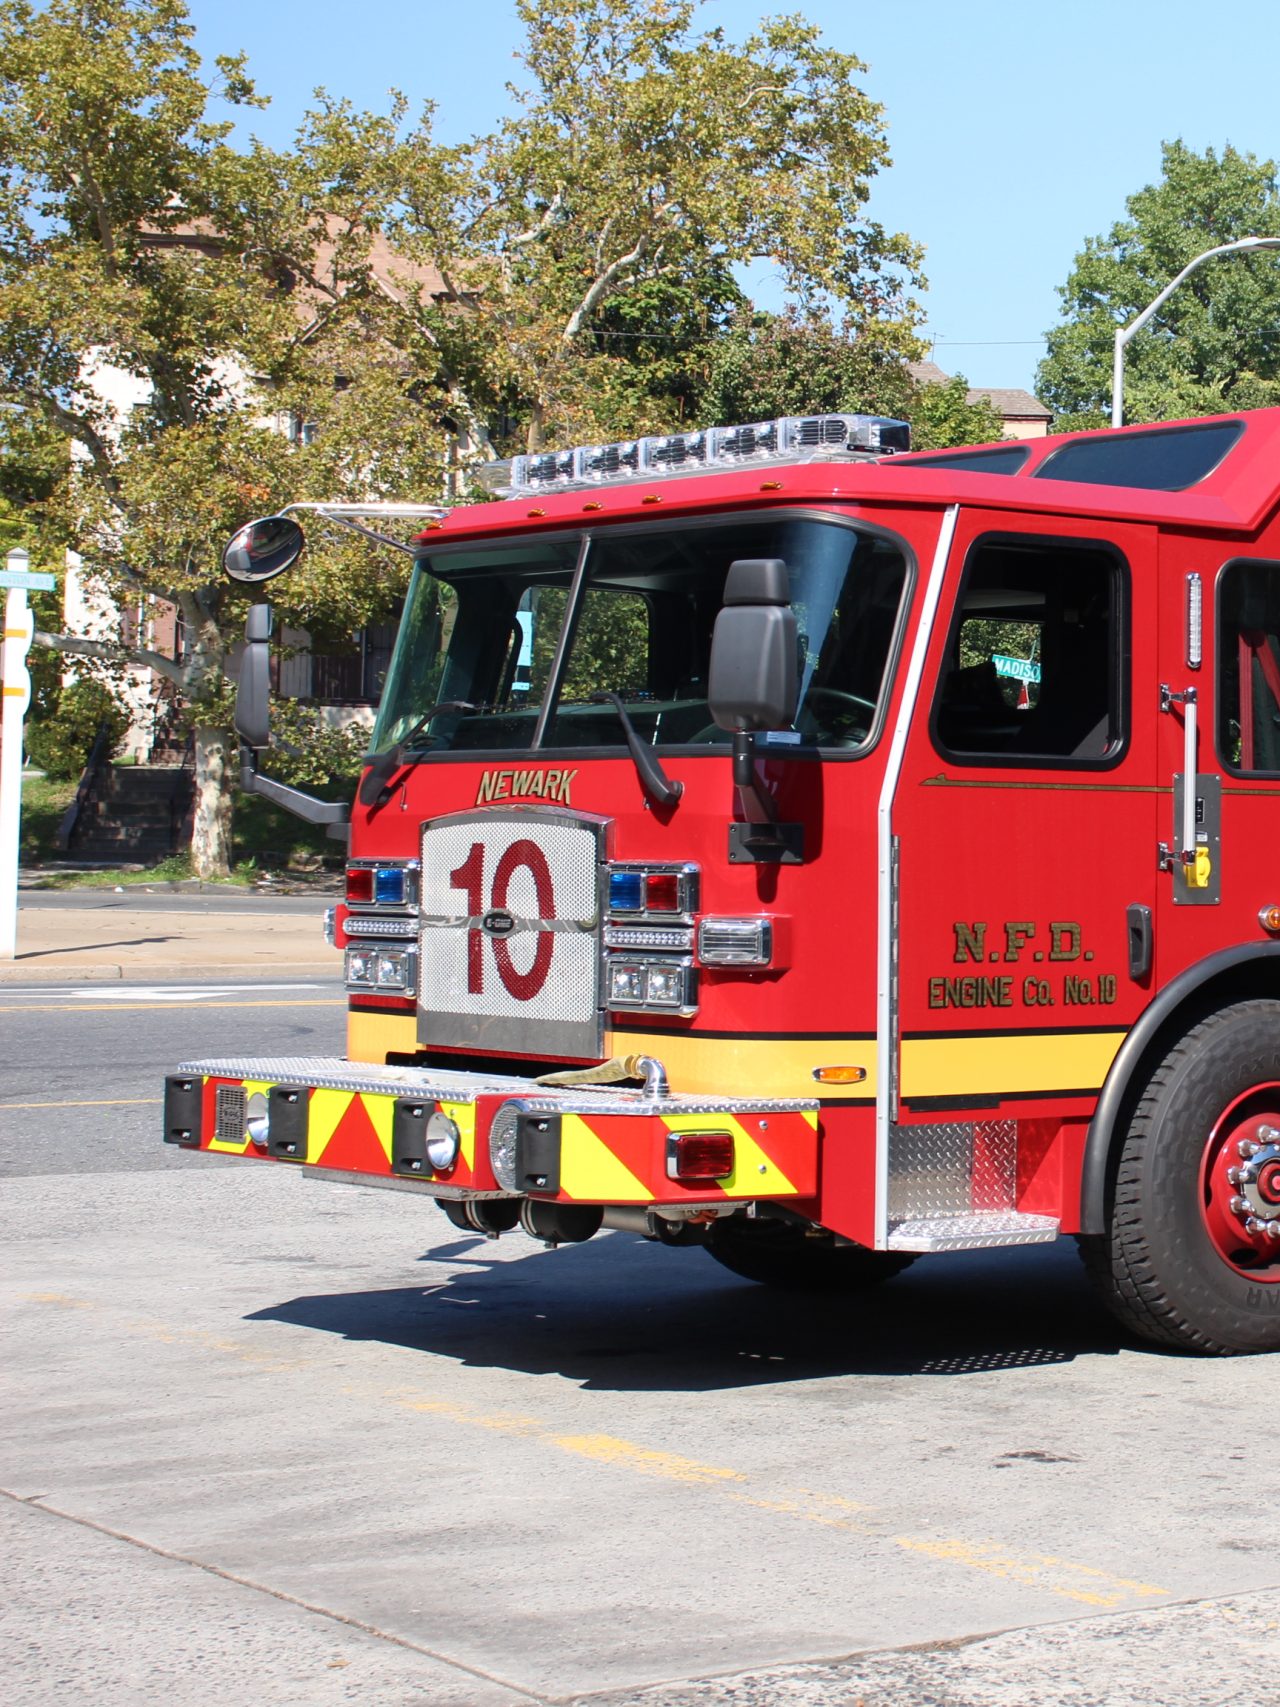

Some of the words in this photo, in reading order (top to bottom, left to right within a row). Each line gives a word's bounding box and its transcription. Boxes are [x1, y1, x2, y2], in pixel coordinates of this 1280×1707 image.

[475, 769, 578, 806] NEWARK
[450, 839, 556, 1001] 10
[954, 922, 1094, 963] N.F.D.
[928, 976, 1014, 1009] ENGINE
[1023, 975, 1055, 1006] Co.
